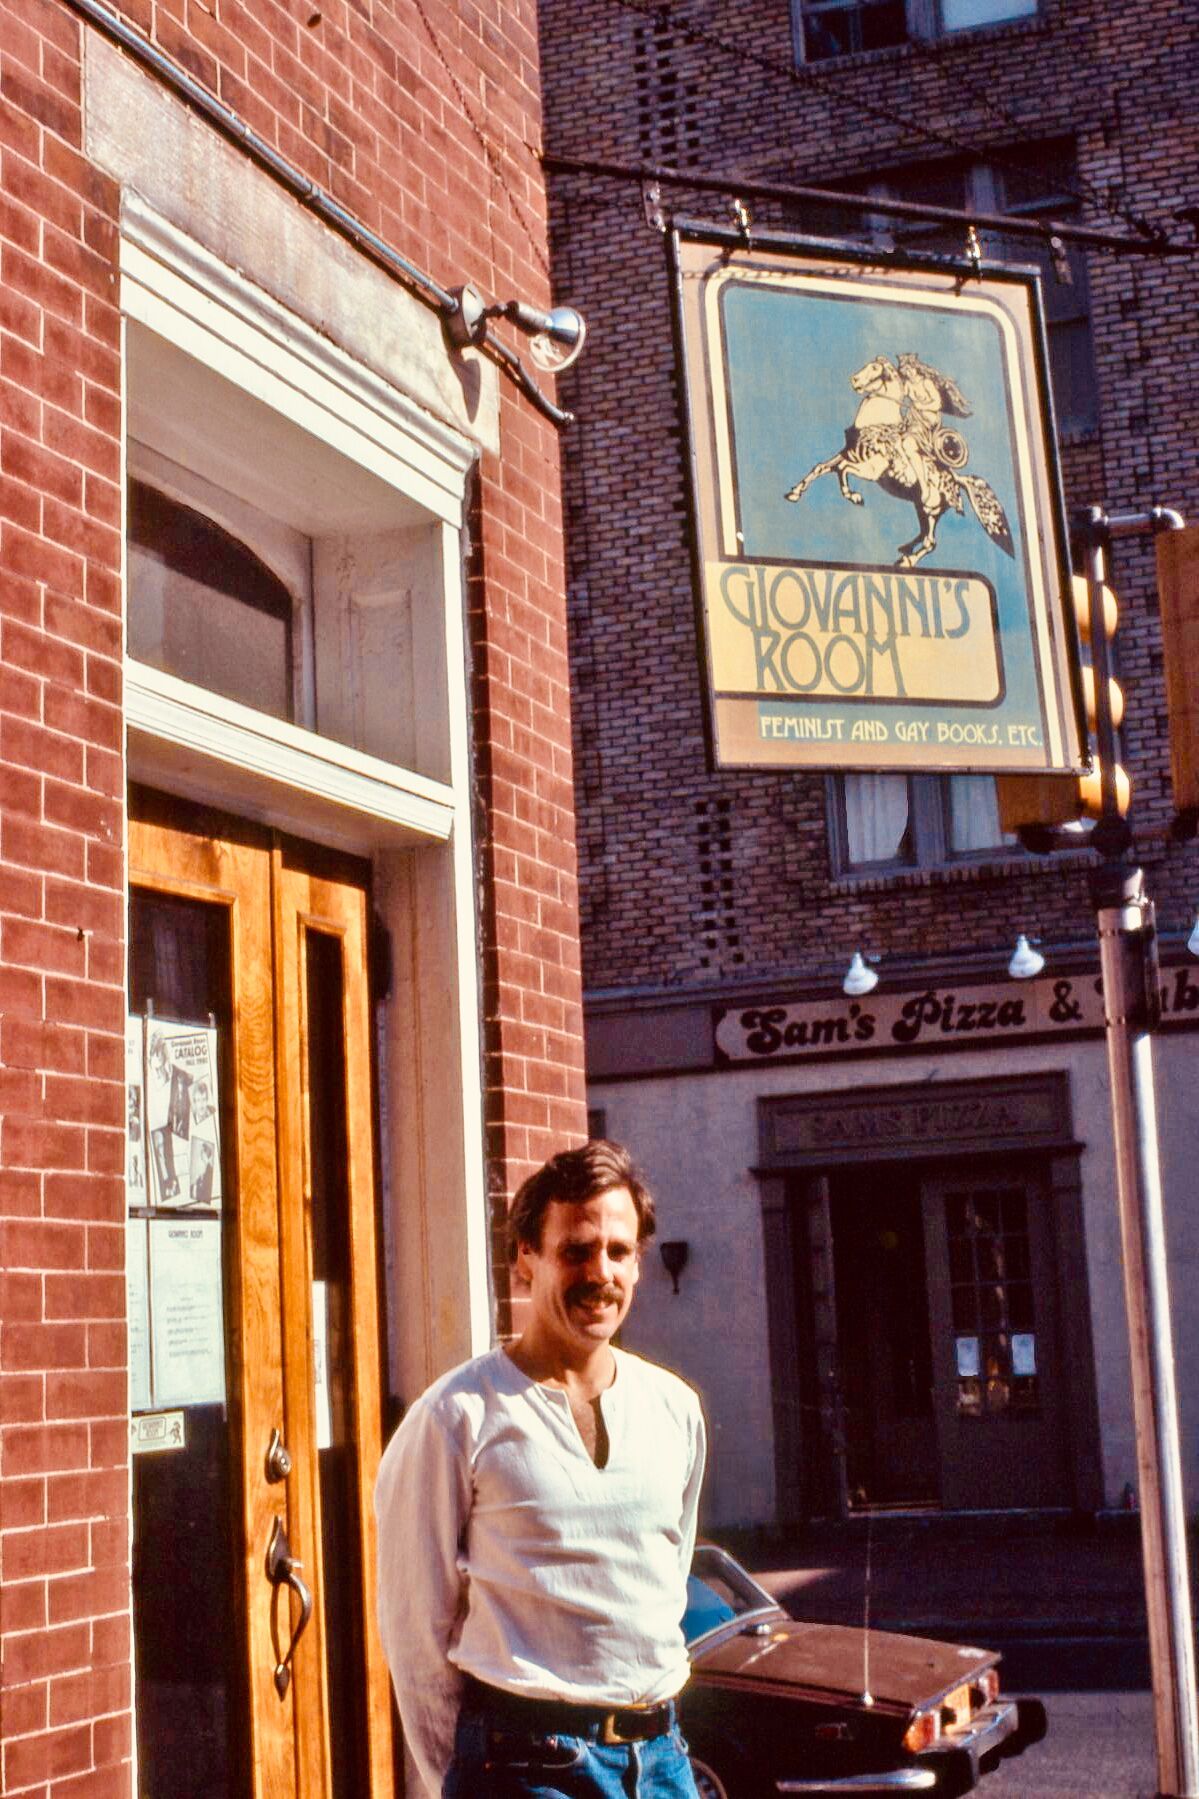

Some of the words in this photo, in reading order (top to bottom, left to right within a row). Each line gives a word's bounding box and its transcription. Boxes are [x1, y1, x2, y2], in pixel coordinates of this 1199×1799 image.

[719, 565, 971, 640] GIOVANNI'S
[752, 629, 908, 697] ROOM
[760, 715, 845, 740] FEMINIST
[850, 719, 889, 742] AND
[895, 721, 930, 744] GAY
[1008, 726, 1043, 747] ETC.
[175, 1044, 208, 1059] CATALOG
[741, 1003, 877, 1055] Sam's
[891, 991, 1027, 1043] Pizza
[1049, 980, 1084, 1023] &
